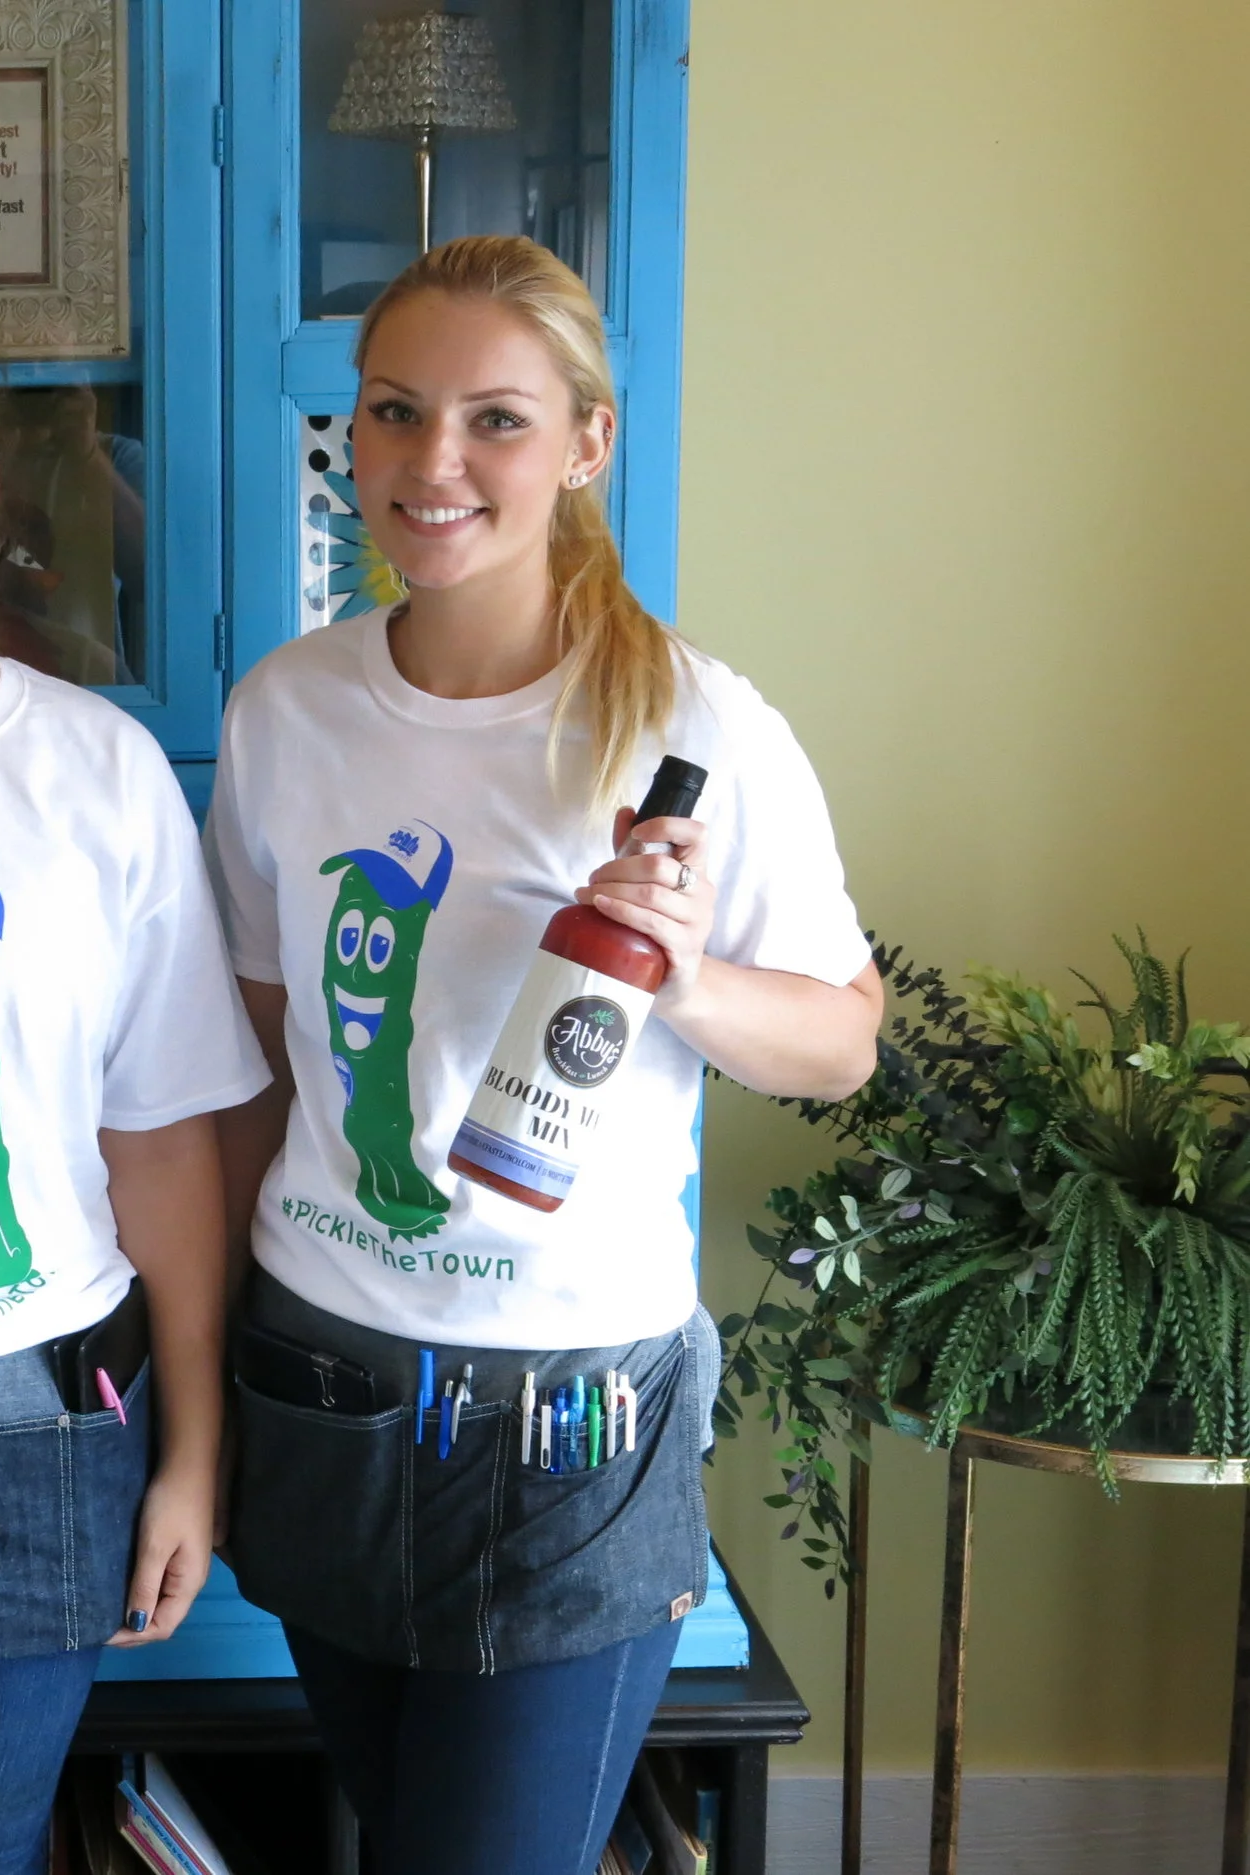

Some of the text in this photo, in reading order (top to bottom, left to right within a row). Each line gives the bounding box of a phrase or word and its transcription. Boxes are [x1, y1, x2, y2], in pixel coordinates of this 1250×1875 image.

[552, 1016, 622, 1068] Abby's
[552, 1046, 609, 1081] Breakfast Lunch
[484, 1066, 570, 1119] BLOODY
